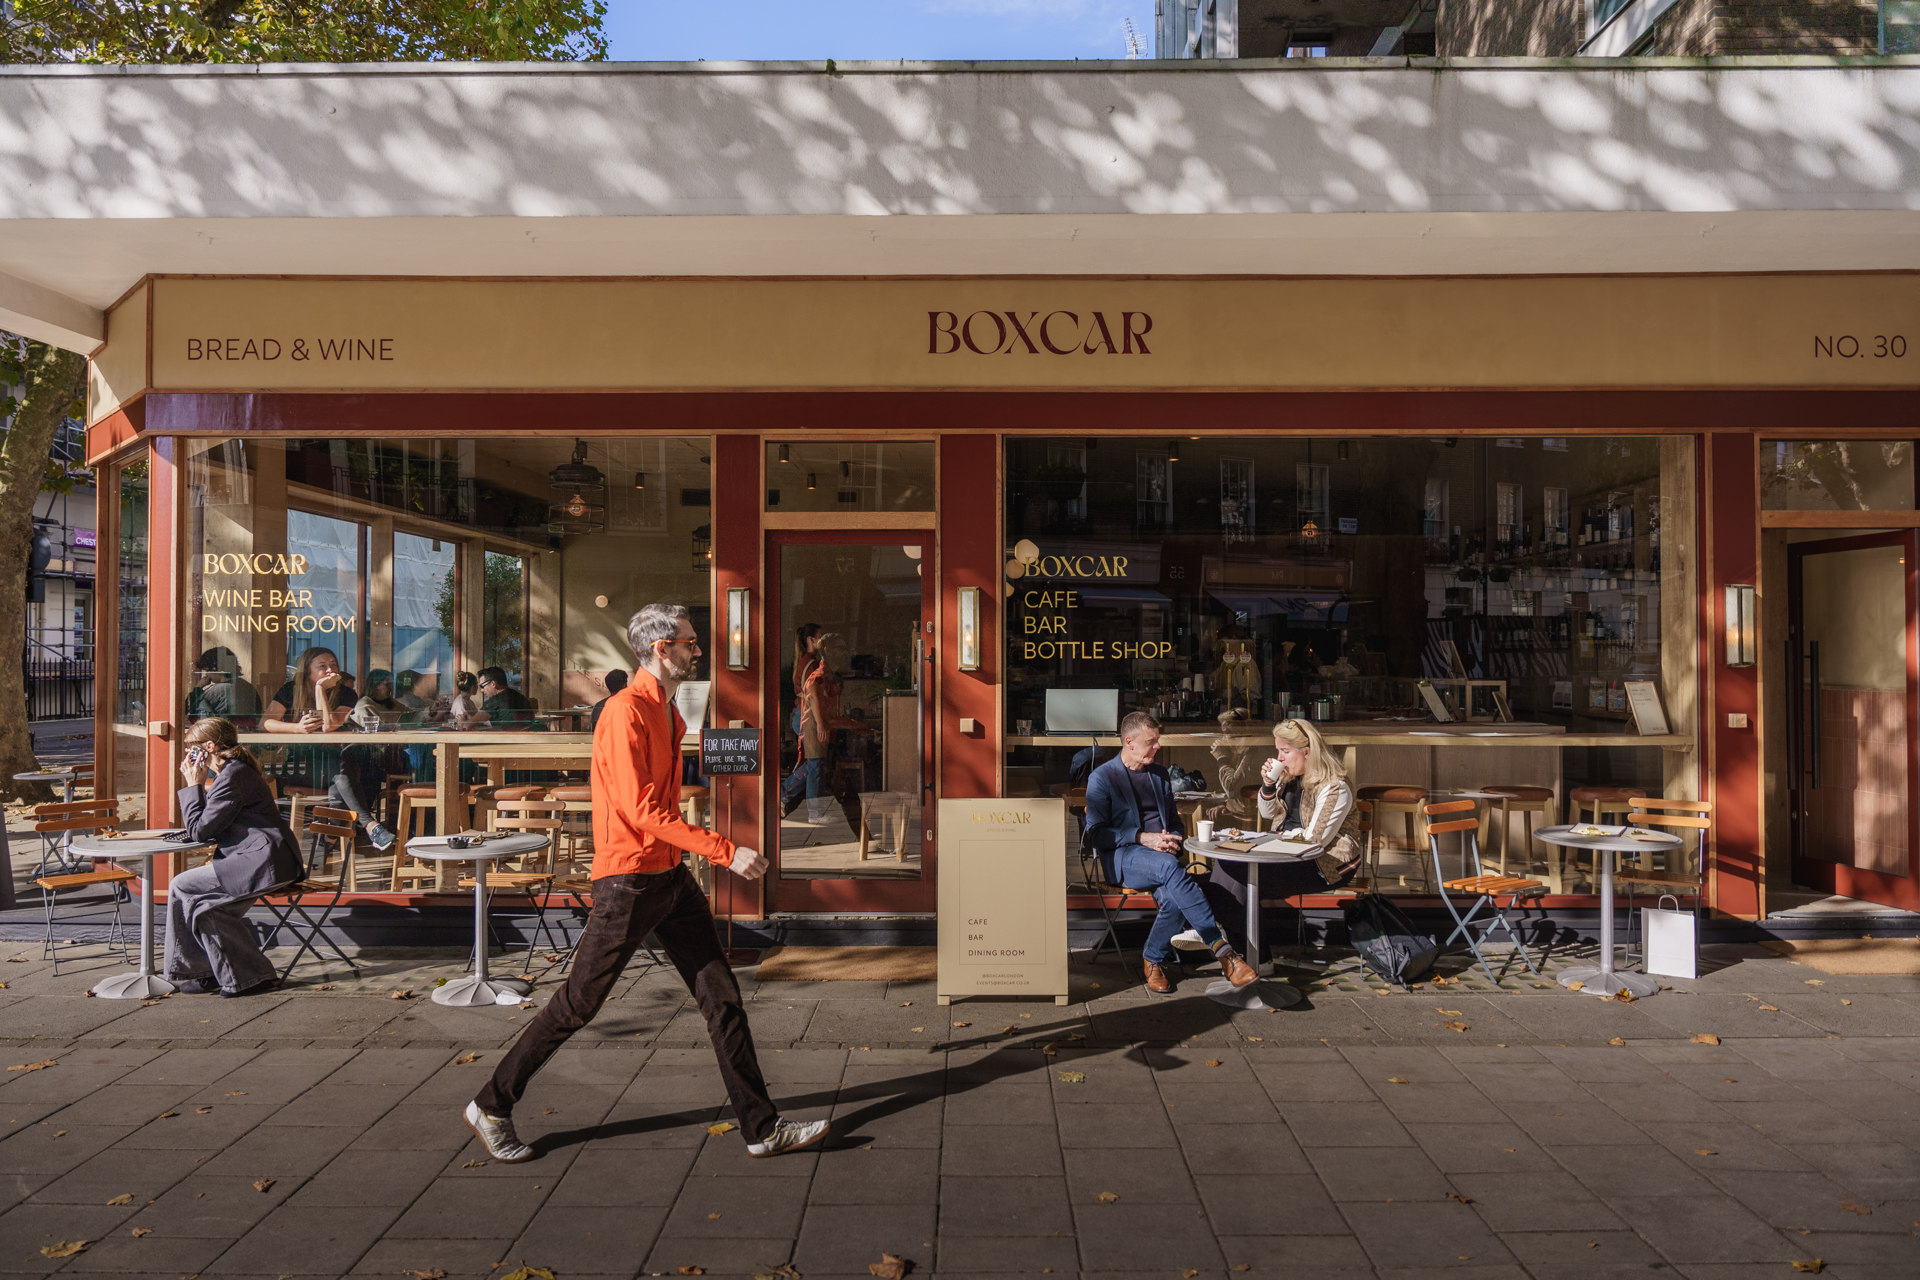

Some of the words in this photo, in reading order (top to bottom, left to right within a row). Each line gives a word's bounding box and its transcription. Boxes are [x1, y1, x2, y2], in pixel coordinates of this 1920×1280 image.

[927, 310, 1153, 355] BOXCAR
[187, 338, 282, 361] BREAD
[291, 338, 310, 361] &
[317, 338, 394, 361] WINE
[1814, 335, 1864, 358] NO.
[1873, 334, 1907, 358] 30
[203, 553, 306, 575] BOXCAR
[1024, 555, 1128, 577] BOXCAR
[203, 589, 263, 608] WINE
[269, 589, 313, 608] BAR
[1024, 590, 1078, 609] CAFE
[202, 614, 279, 633] DINING
[286, 615, 355, 633] ROOM
[1024, 616, 1067, 634] BAR
[1024, 641, 1104, 659] BOTTLE
[1111, 641, 1172, 659] SHOP
[703, 738, 719, 751] FOR
[720, 738, 739, 751] TAKE
[740, 738, 759, 751] AWAY
[713, 764, 732, 772] OTHER
[733, 764, 748, 772] DOOR
[724, 755, 735, 763] USE
[972, 811, 1031, 825] BOXCAR
[968, 918, 988, 926] CAFE
[968, 949, 998, 957] DINING
[1000, 949, 1025, 957] ROOM
